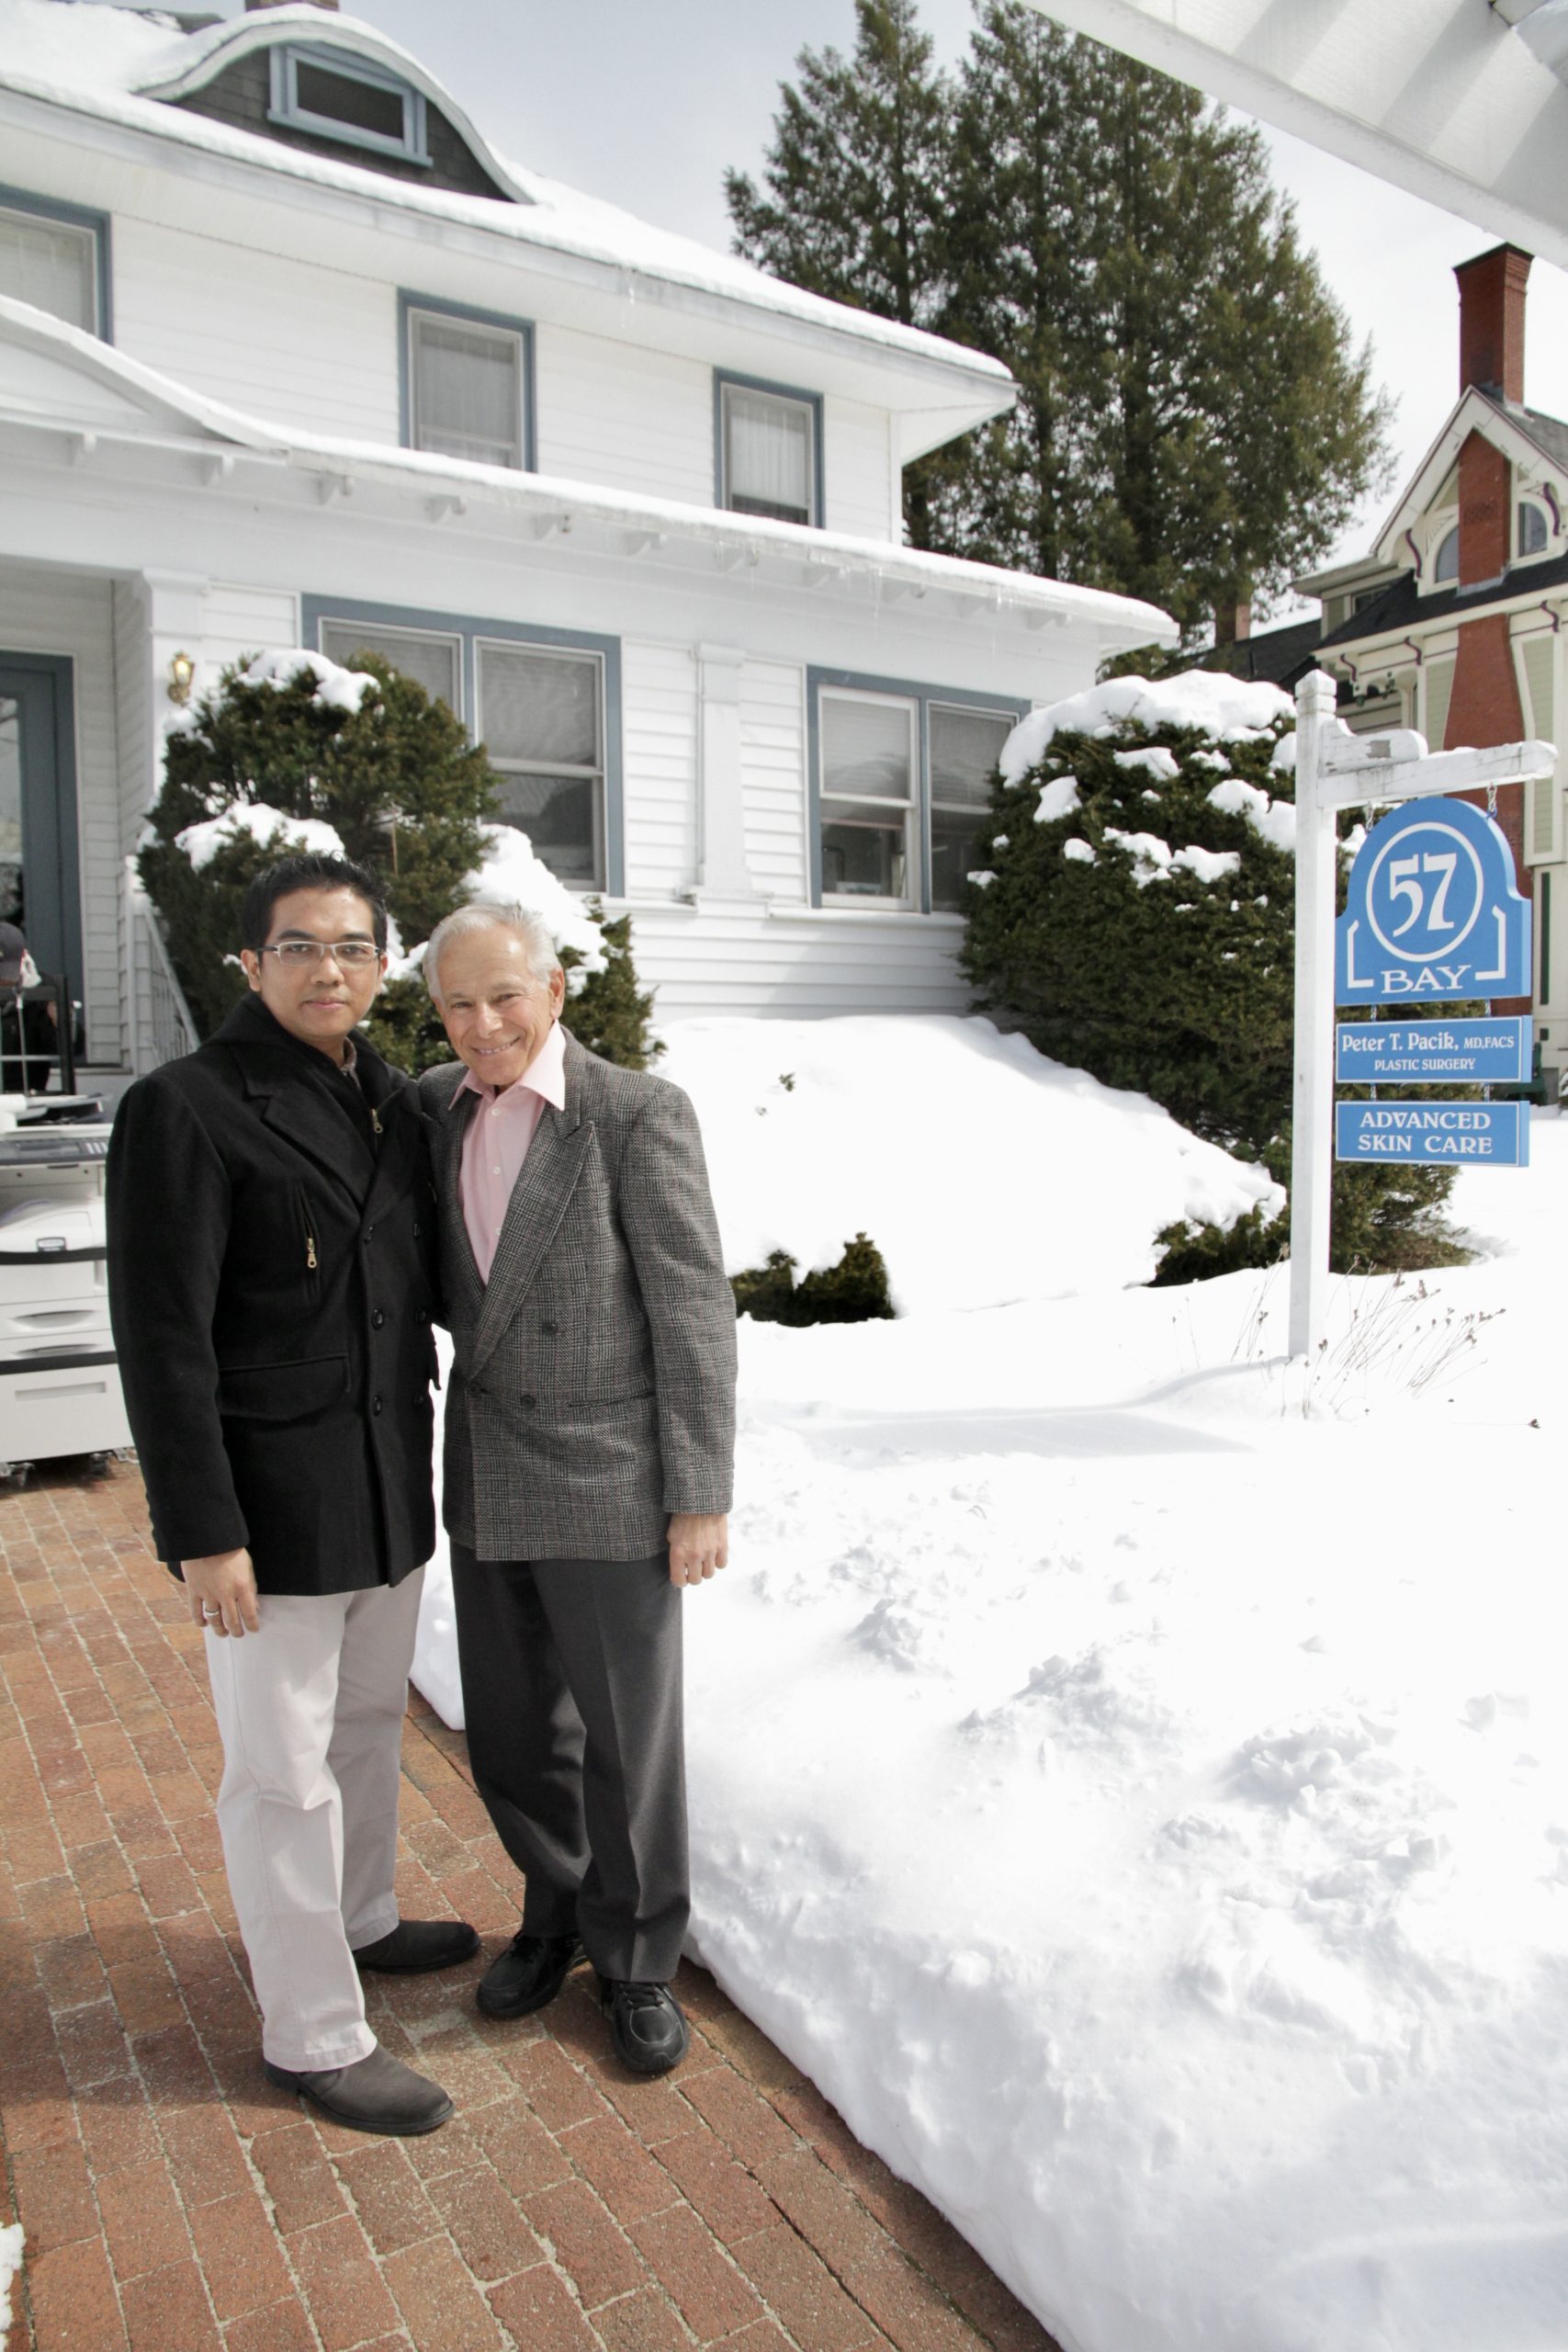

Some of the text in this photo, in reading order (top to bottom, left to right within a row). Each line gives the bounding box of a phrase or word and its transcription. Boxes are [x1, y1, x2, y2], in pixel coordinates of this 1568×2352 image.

[1389, 852, 1459, 938] 57
[1381, 964, 1472, 994] BAY
[1342, 1035, 1385, 1052] Peter
[1389, 1032, 1404, 1051] T.
[1407, 1031, 1459, 1052] Pacik,
[1374, 1057, 1476, 1071] PLASTIC SURGERY
[1359, 1110, 1493, 1130] ADVANCED
[1358, 1134, 1494, 1155] SKIN CARE
